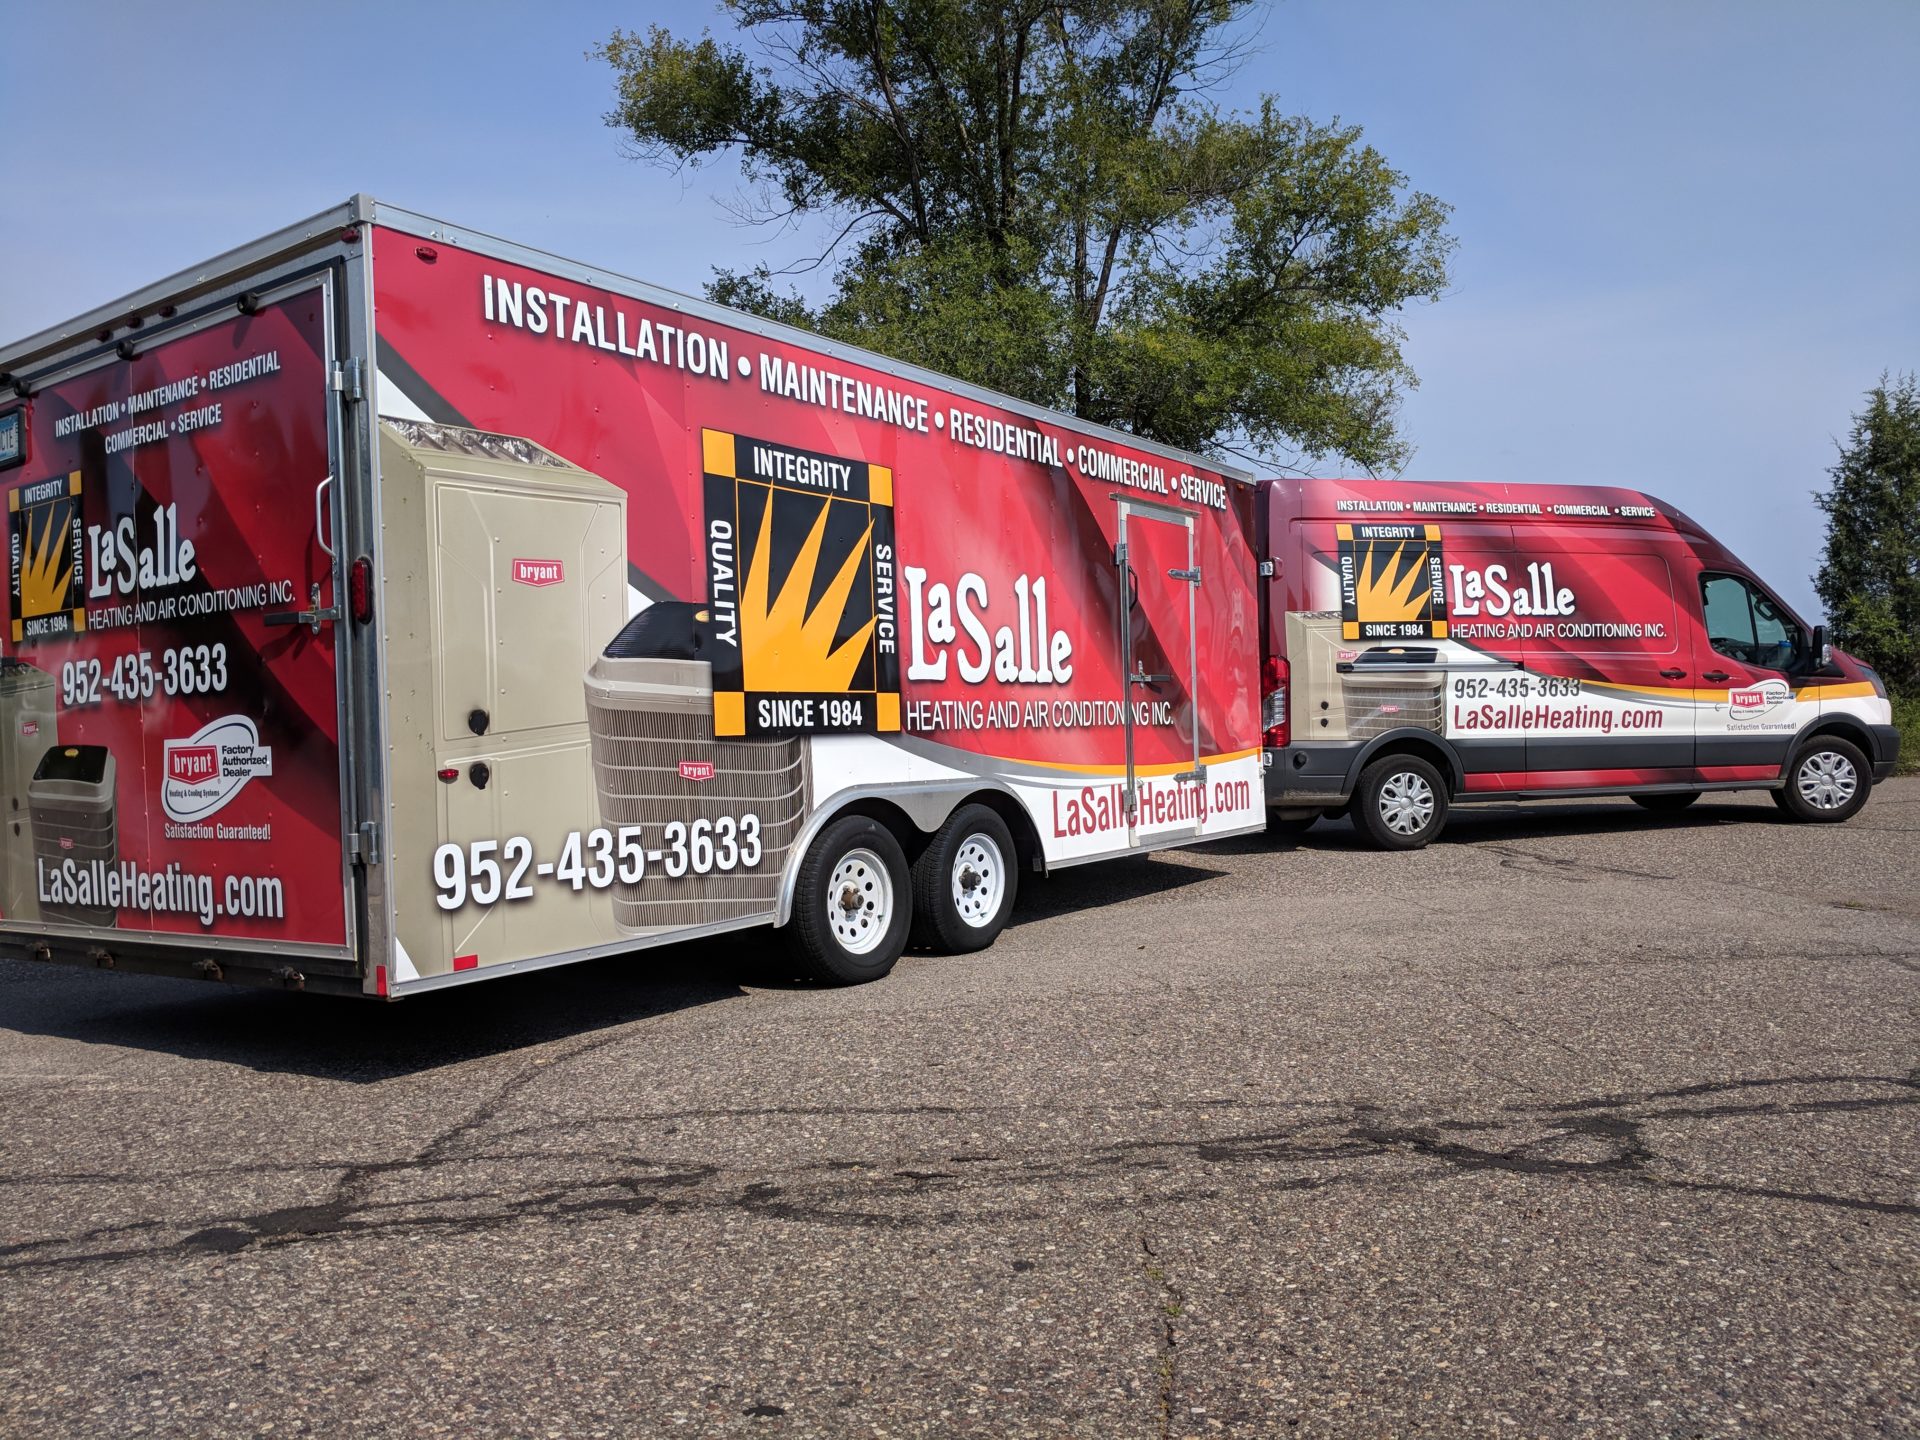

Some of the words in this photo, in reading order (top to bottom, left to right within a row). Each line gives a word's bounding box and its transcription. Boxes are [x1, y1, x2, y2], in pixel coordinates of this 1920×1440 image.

[55, 402, 119, 438] INSTALLATION
[128, 376, 199, 413] MAINTENANCE
[209, 351, 281, 390] RESIDENTIAL
[483, 274, 729, 380] INSTALLATION
[759, 353, 929, 432] MAINTENANCE
[950, 408, 1063, 467] RESIDENTIAL
[1078, 446, 1168, 494] COMMERCIAL
[1180, 474, 1226, 510] SERVICE
[105, 421, 169, 455] COMMERCIAL
[178, 404, 222, 433] SERVICE
[753, 446, 851, 491] INTEGRITY
[24, 480, 63, 504] INTEGRITY
[1336, 500, 1404, 512] INSTALLATION
[1413, 501, 1477, 514] MAINTENANCE
[1486, 502, 1543, 515] RESIDENTIAL
[1553, 504, 1611, 516] COMMERCIAL
[1620, 506, 1655, 517] SERVICE
[1361, 526, 1415, 539] INTEGRITY
[12, 533, 20, 597] QUALITY
[72, 518, 84, 585] SERVICE
[87, 502, 196, 599] LaSalle
[520, 563, 558, 581] bryant
[710, 519, 737, 647] QUALITY
[1341, 556, 1355, 606] QUALITY
[1430, 557, 1444, 605] SERVICE
[875, 543, 895, 654] SERVICE
[1449, 562, 1576, 616] LaSalle
[88, 605, 133, 630] HEATING
[134, 602, 157, 625] AND
[158, 599, 175, 622] AIR
[179, 583, 267, 617] CONDITIONING
[269, 580, 296, 604] INC.
[26, 618, 49, 637] SINCE
[49, 615, 68, 634] 1984
[905, 565, 1073, 683] LaSalle
[1365, 625, 1397, 636] SINCE
[1399, 624, 1424, 636] 1984
[1451, 624, 1505, 638] HEATING
[1507, 624, 1533, 638] AND
[1535, 624, 1555, 638] AIR
[1557, 624, 1642, 638] CONDITIONING
[1644, 624, 1666, 638] INC.
[62, 642, 228, 705] 952-435-3633
[1454, 677, 1580, 699] 952-435-3633
[759, 700, 814, 728] SINCE
[819, 700, 862, 726] 1984
[1735, 694, 1760, 704] bryant
[907, 701, 983, 731] HEATING
[986, 701, 1021, 728] AND
[1023, 701, 1049, 728] AIR
[1152, 701, 1174, 725] INC.
[1454, 704, 1663, 734] LaSalleHeating.com
[1726, 723, 1759, 731] Satisfaction
[174, 754, 211, 776] bryant
[222, 745, 254, 757] Factory
[222, 755, 268, 766] Authorized
[223, 767, 252, 777] Dealer
[683, 765, 711, 777] bryant
[165, 822, 214, 839] Satisfaction
[216, 823, 271, 840] Guaranteed!
[433, 813, 762, 910] 952-435-3633
[38, 858, 284, 926] LaSalleHeating.com
